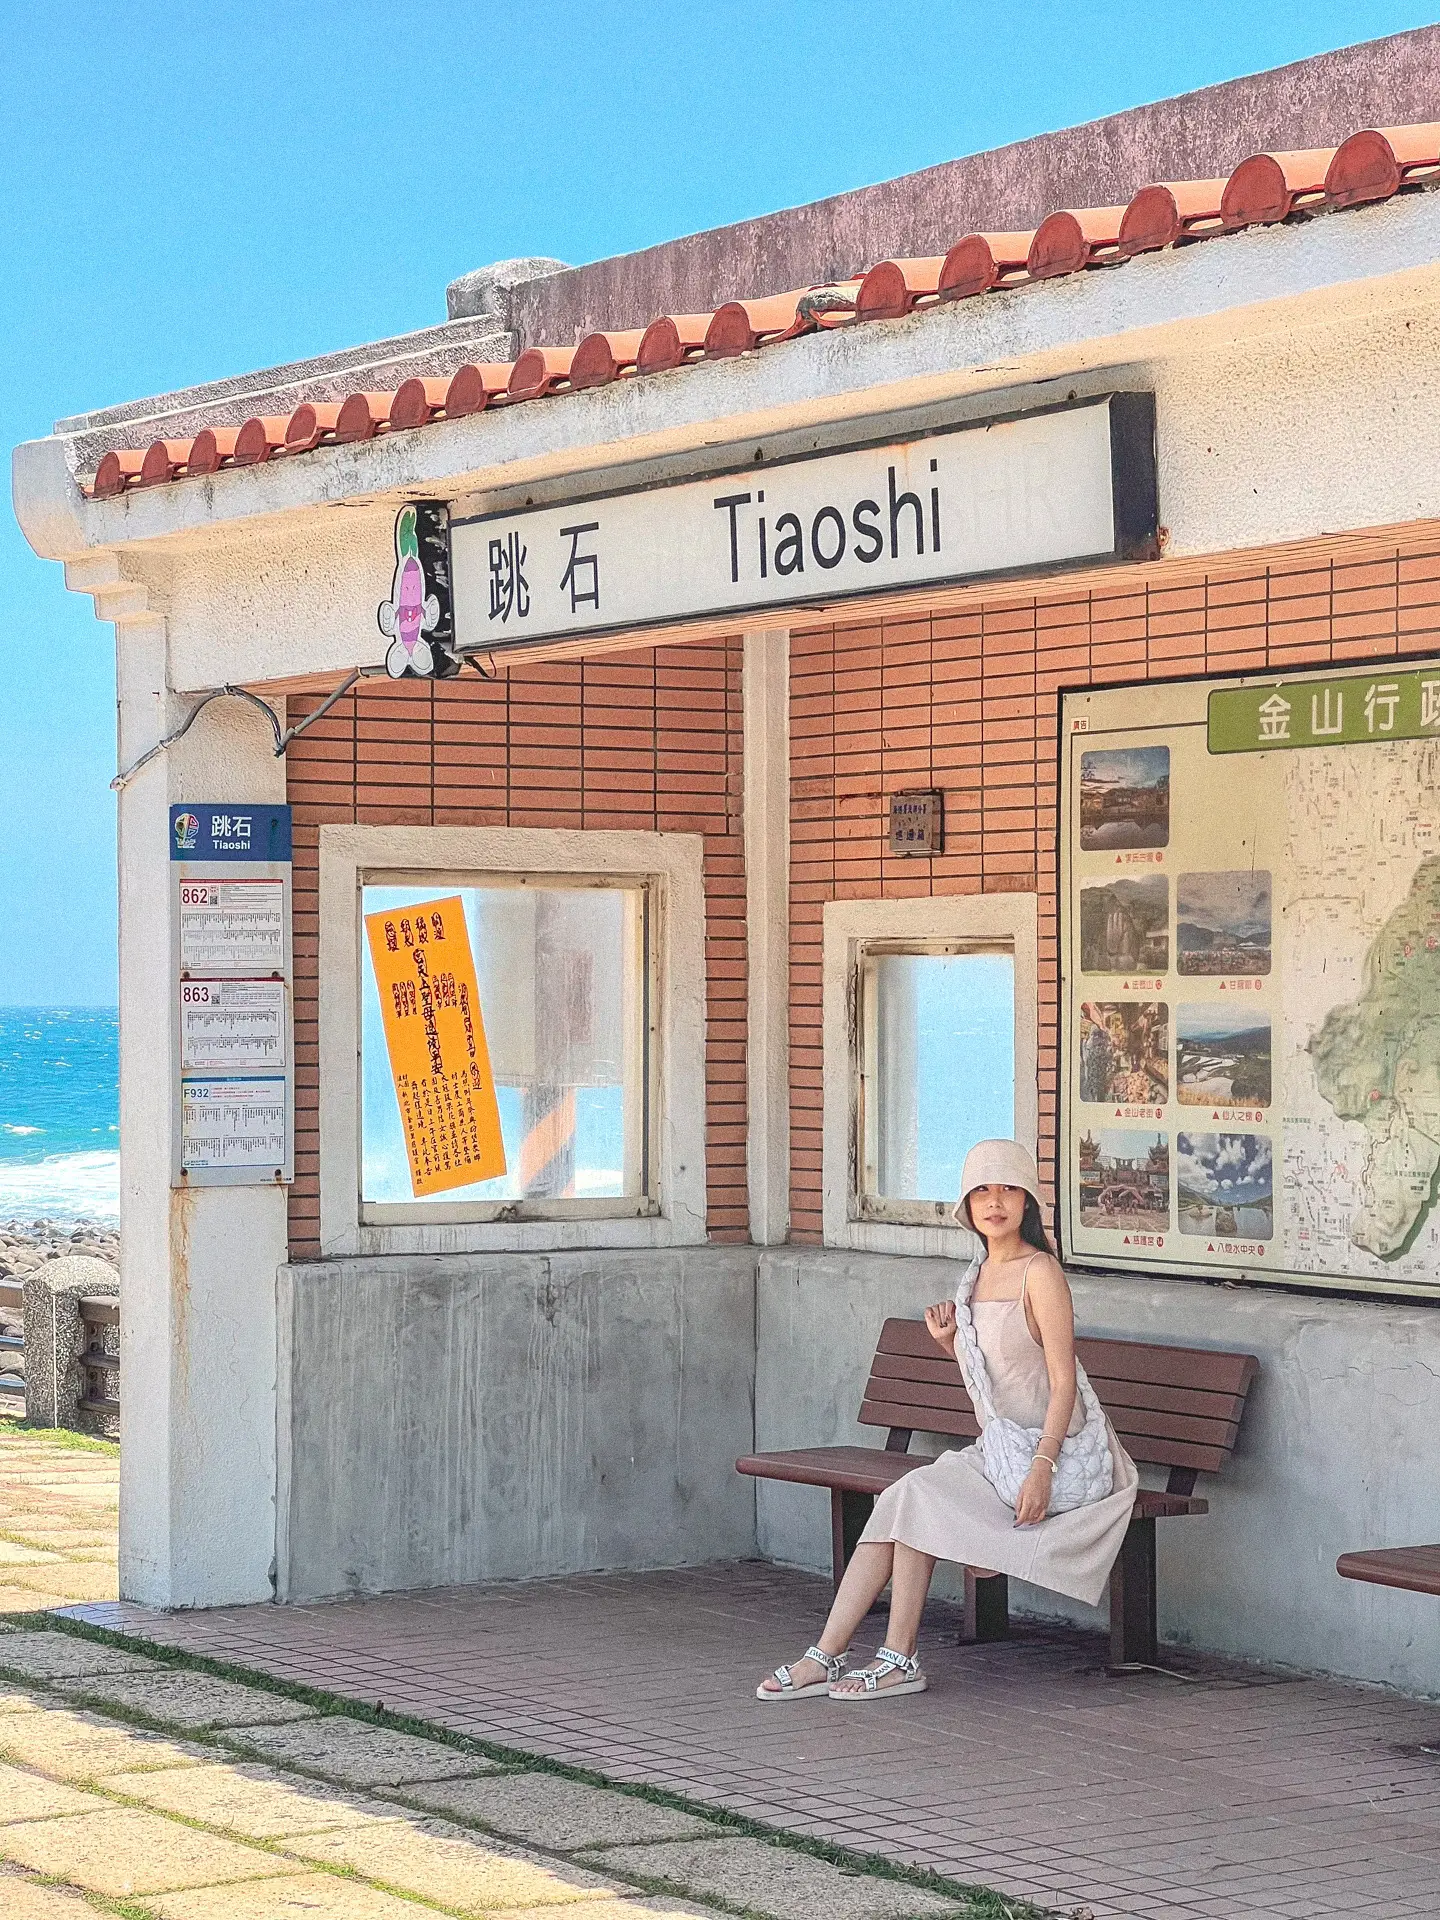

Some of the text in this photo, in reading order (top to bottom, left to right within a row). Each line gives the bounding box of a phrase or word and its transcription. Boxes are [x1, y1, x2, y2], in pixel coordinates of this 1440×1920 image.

[714, 459, 941, 583] Tiaoshi
[487, 522, 600, 623] 跳石
[211, 815, 252, 837] 跳石
[213, 840, 250, 849] Tiaoshi
[182, 888, 208, 904] 862
[183, 987, 209, 1003] 863
[183, 1088, 209, 1098] F932
